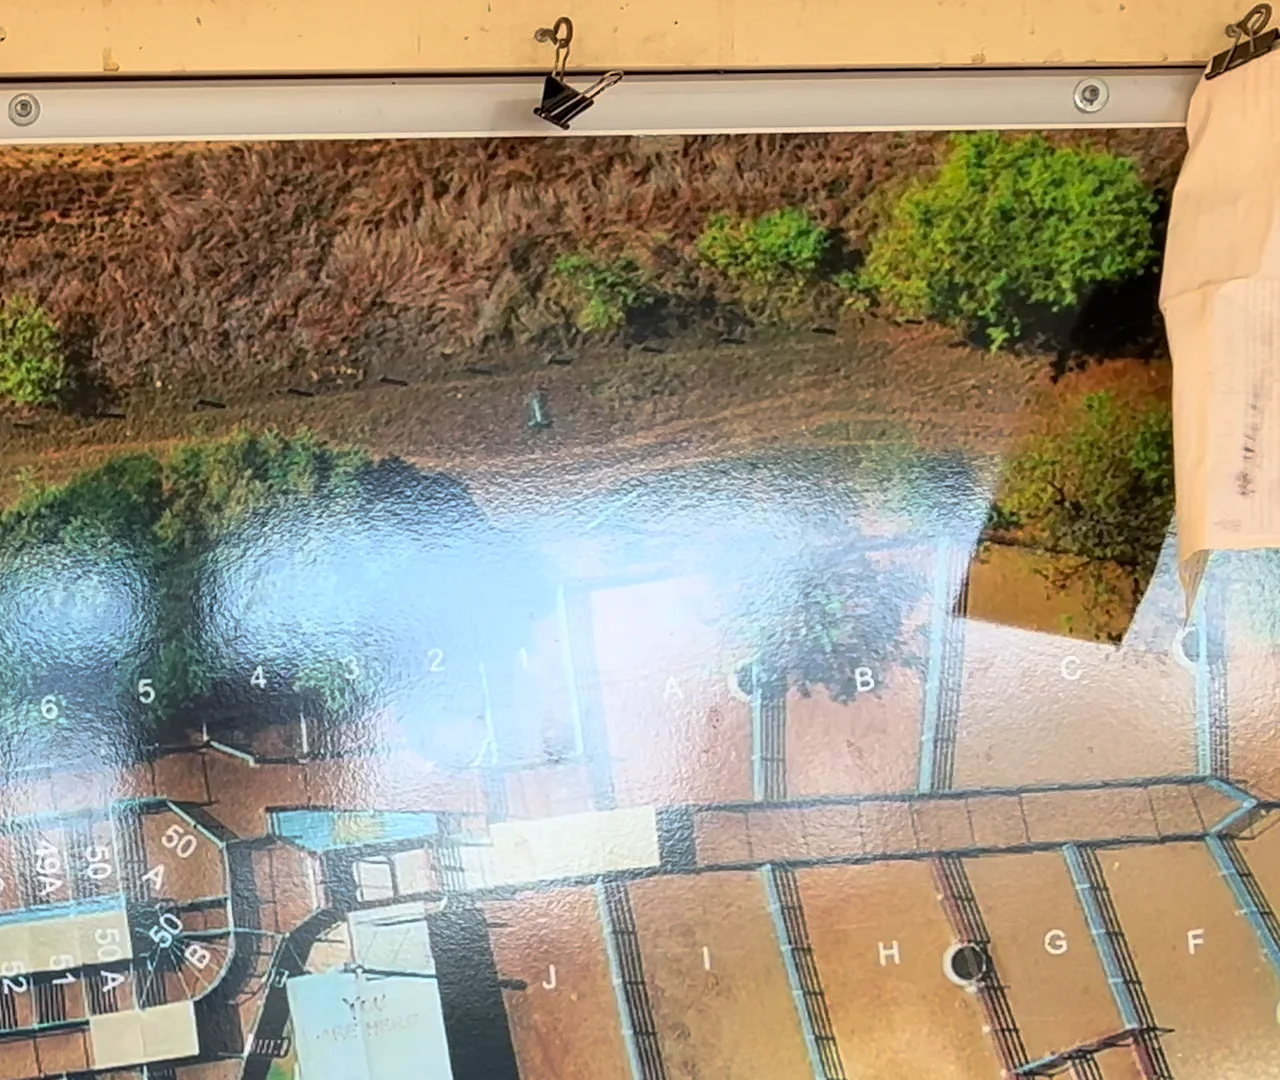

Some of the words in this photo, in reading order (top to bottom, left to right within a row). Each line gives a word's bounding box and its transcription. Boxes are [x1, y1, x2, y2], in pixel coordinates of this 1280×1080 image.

[343, 655, 360, 680] 3
[428, 648, 445, 672] 2
[1059, 656, 1083, 681] C
[249, 665, 267, 690] 4
[854, 666, 875, 693] B
[138, 679, 156, 704] 5
[40, 695, 59, 720] 6
[160, 824, 197, 858] 50
[84, 845, 112, 880] 50
[141, 864, 165, 891] A
[94, 928, 120, 964] 50
[148, 912, 183, 949] 50
[184, 944, 211, 969] B
[878, 941, 899, 965] H
[1044, 929, 1068, 954] G
[1188, 929, 1206, 954] F
[49, 954, 77, 987] 51
[702, 946, 711, 970] I
[0, 960, 28, 996] 52
[100, 970, 125, 993] A
[541, 965, 557, 990] J
